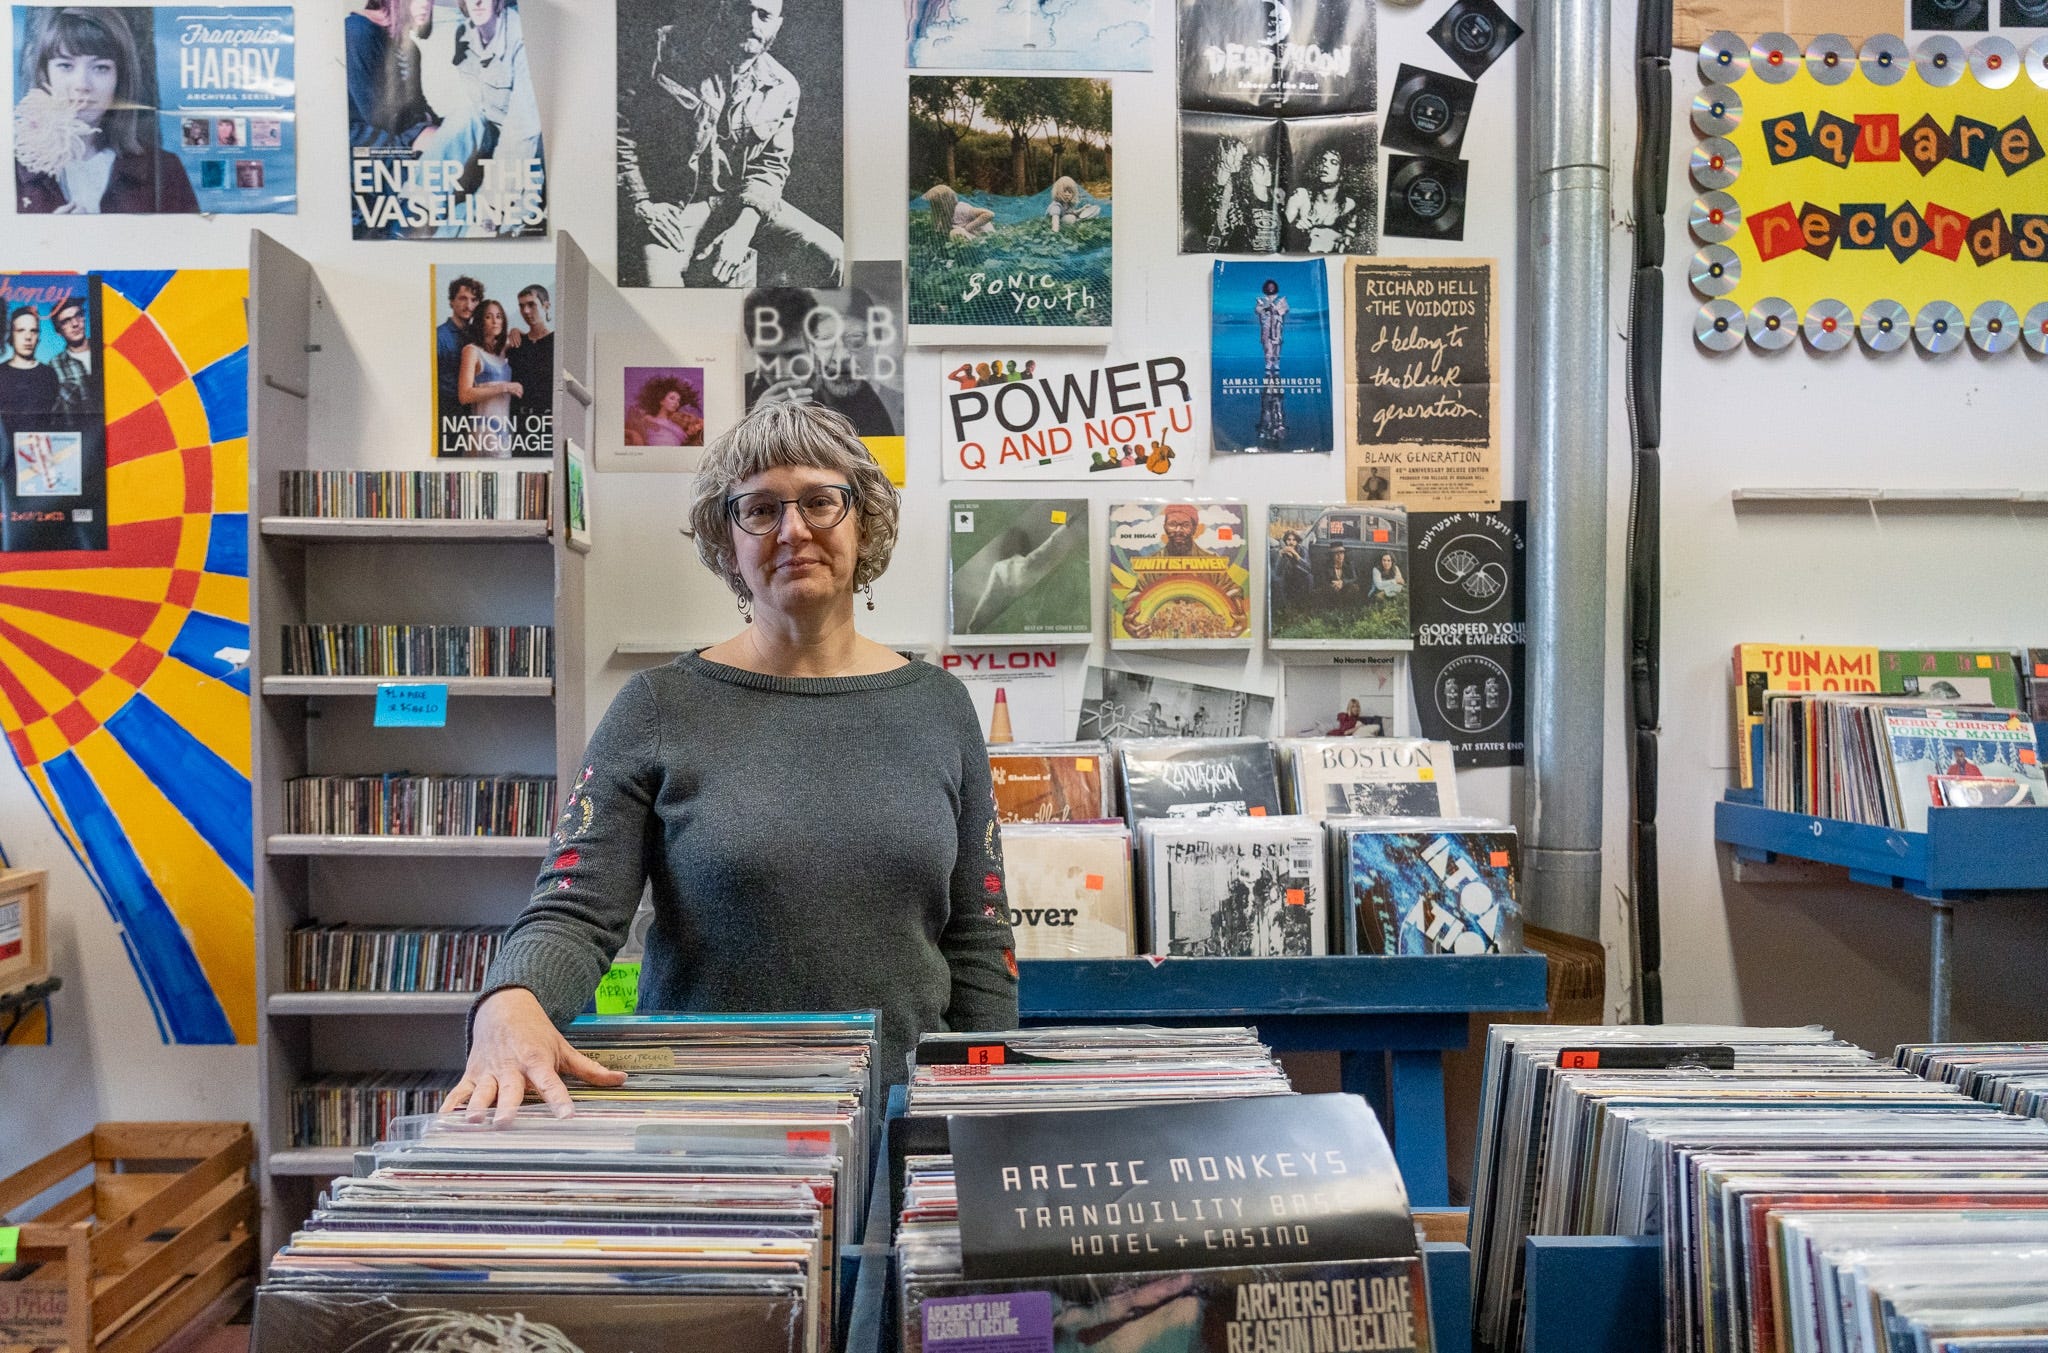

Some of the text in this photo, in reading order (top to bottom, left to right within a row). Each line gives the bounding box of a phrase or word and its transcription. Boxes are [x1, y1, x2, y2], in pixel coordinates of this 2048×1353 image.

[181, 24, 279, 46] Françoise
[181, 47, 280, 89] HARDY
[1270, 81, 1281, 89] of
[1299, 82, 1319, 90] Past
[1774, 119, 2029, 164] square
[353, 158, 542, 193] ENTER THE
[354, 194, 546, 228] VASELINES
[1763, 212, 2048, 256] records
[963, 271, 1055, 302] SONIC
[1366, 279, 1478, 296] RICHARD HELL
[1372, 300, 1401, 316] THE
[1406, 300, 1475, 317] VOIDOIDS
[1392, 326, 1447, 372] belong
[1447, 325, 1469, 347] to
[755, 354, 896, 380] MOULD
[1370, 366, 1400, 388] the
[1222, 378, 1321, 386] KAMASI WASHINGTON
[950, 357, 1192, 442] POWER
[442, 415, 553, 433] NATION OF
[442, 435, 553, 451] LANGUAGE
[960, 443, 987, 470] Q
[1000, 427, 1072, 464] AND
[1085, 411, 1156, 448] NOT
[1169, 405, 1192, 433] U
[1365, 451, 1481, 463] BLANK GENERATION
[1134, 558, 1227, 570] UNITY IS POWER
[1419, 623, 1488, 635] GODSPEED
[1420, 633, 1526, 646] BLACK EMPEROR
[942, 651, 1056, 670] PYLON
[1333, 656, 1395, 664] No Home Record
[1762, 650, 1871, 676] TSUNAMI
[1888, 718, 2028, 731] MERRY CHRISTMS
[1890, 727, 2031, 741] JOHNNY MATHIS
[1322, 746, 1433, 769] BOSTON
[1461, 743, 1472, 751] AT
[980, 1050, 988, 1064] B
[1574, 1056, 1584, 1068] B
[1002, 1151, 1348, 1191] ARCTIC MONKEYS
[1015, 1198, 1243, 1229] TRANQUILITY
[1071, 1232, 1159, 1256] HOTEL
[1204, 1225, 1309, 1250] CASINO
[1236, 1276, 1410, 1320] ARCHERS OF LOAF
[928, 1301, 1011, 1322] ARCHERS OF LOAF
[927, 1317, 1019, 1340] REASON IN DECLINE
[1226, 1312, 1417, 1353] REASON IN DECLINE
